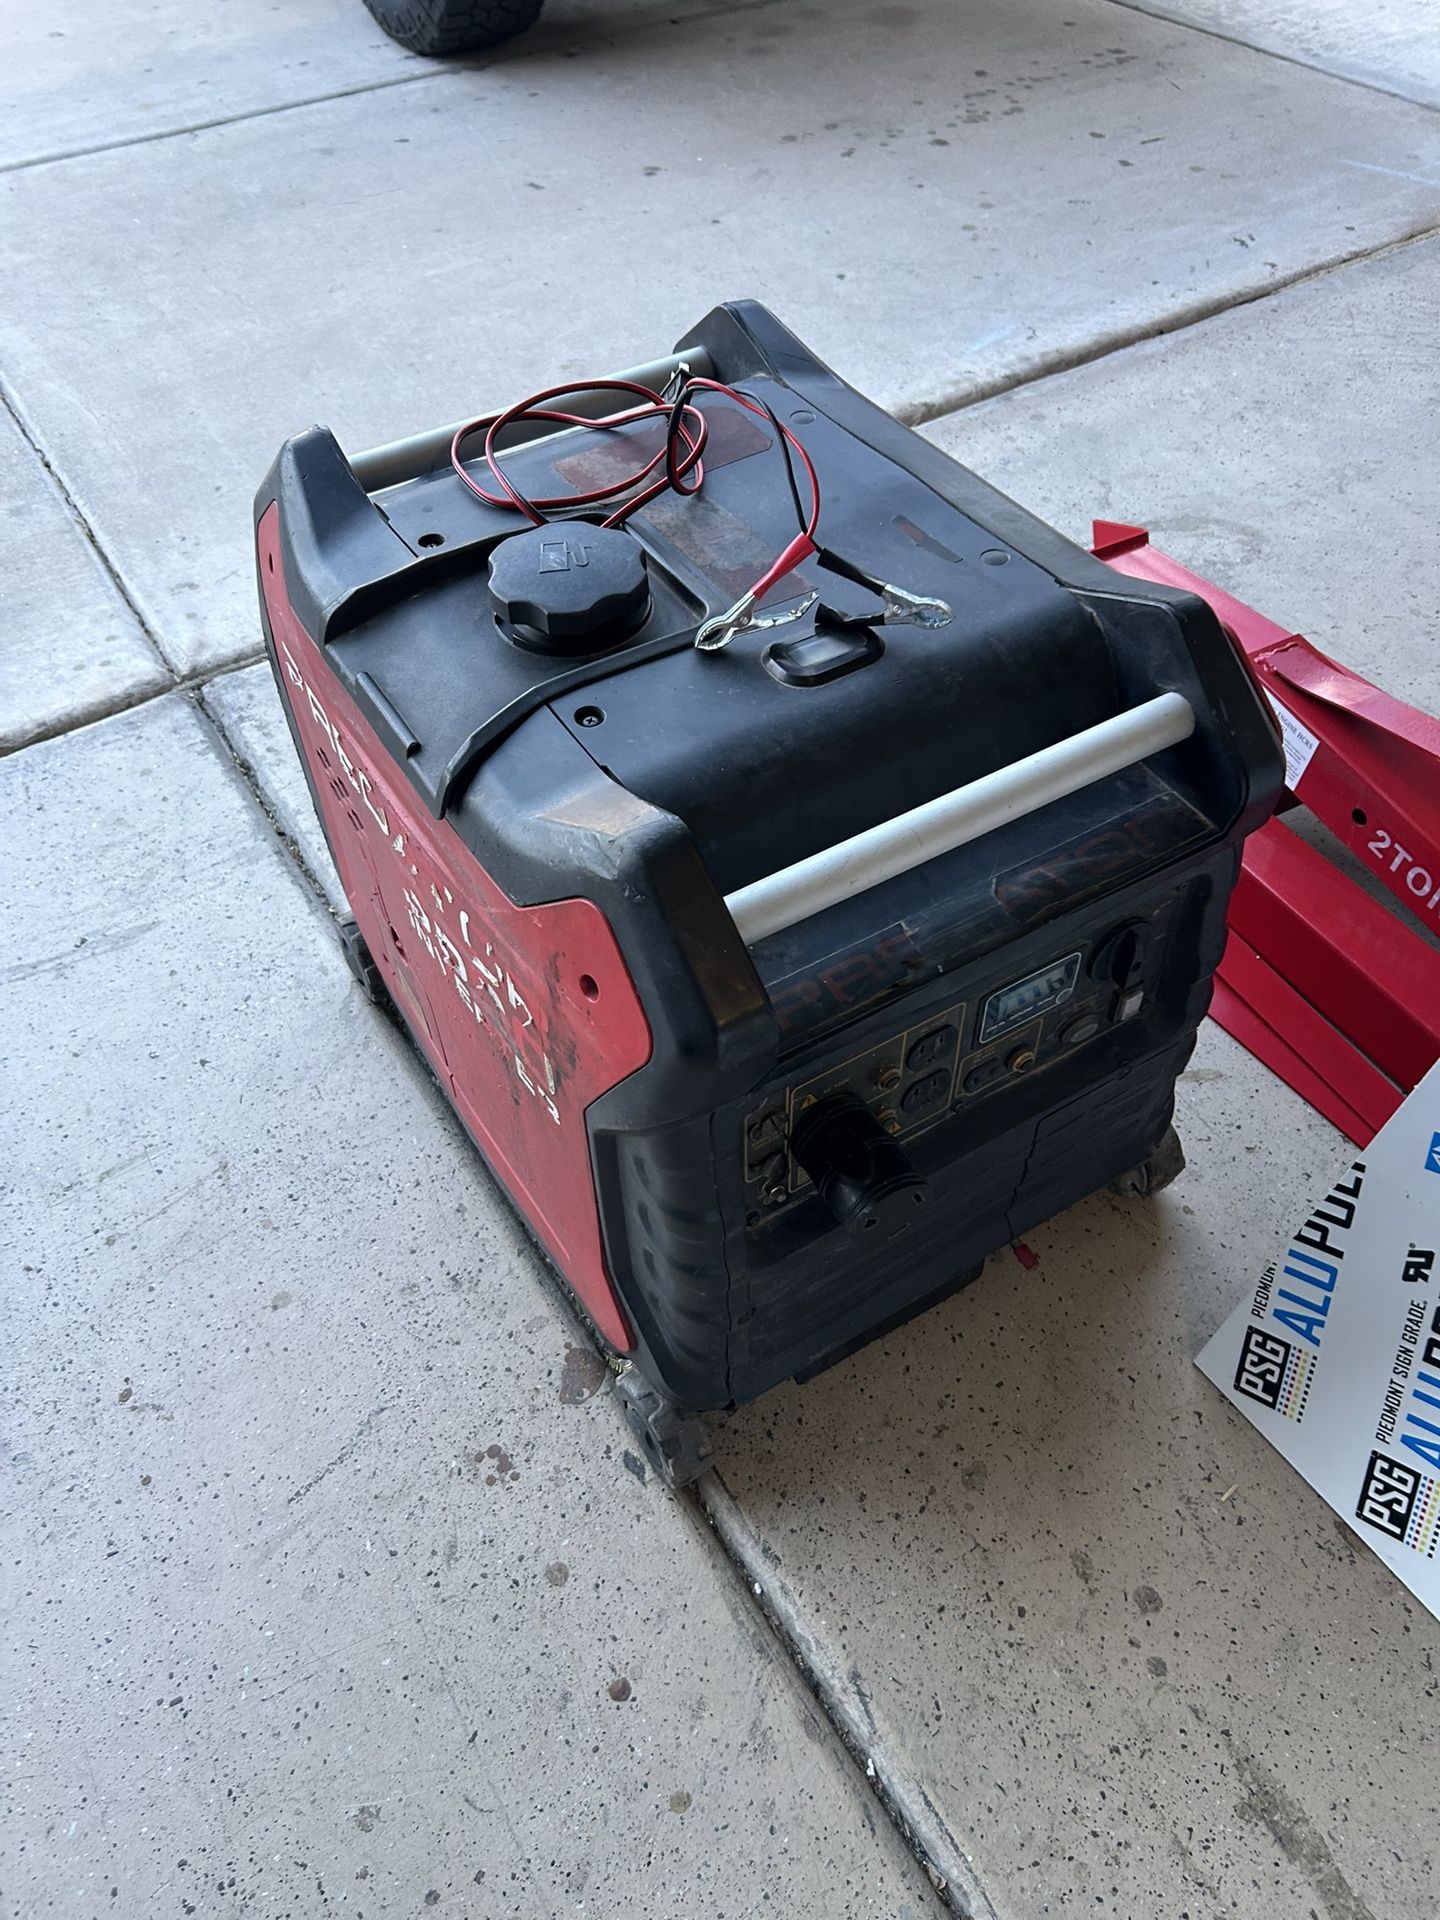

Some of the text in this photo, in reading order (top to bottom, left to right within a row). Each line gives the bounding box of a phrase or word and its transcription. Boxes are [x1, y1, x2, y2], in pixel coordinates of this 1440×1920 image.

[1239, 1331, 1286, 1404] PSG
[1375, 1378, 1406, 1445] PIEDMONT
[1393, 1344, 1415, 1379] SIGN
[1362, 1457, 1415, 1536] PSG
